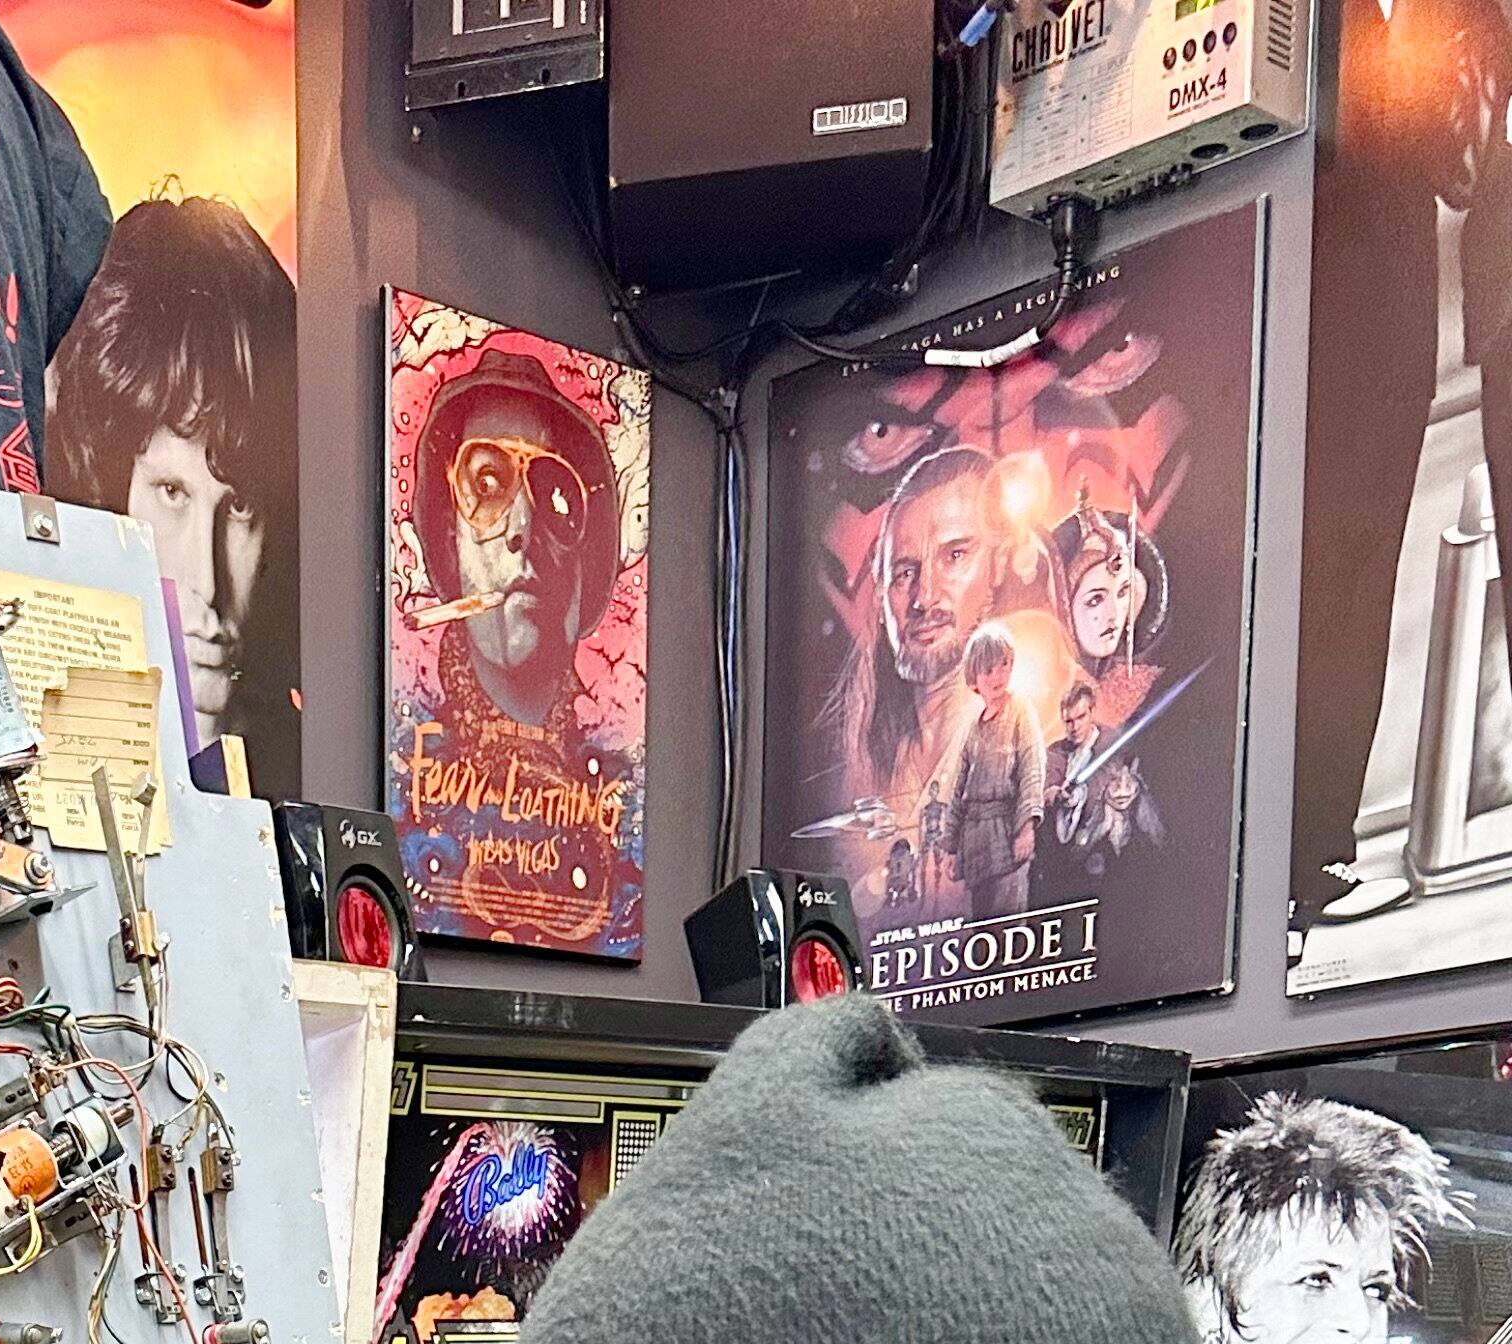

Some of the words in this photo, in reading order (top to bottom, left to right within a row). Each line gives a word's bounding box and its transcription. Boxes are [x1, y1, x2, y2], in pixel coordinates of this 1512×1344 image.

[1169, 67, 1227, 111] DMX-4
[952, 316, 984, 338] HAS
[994, 310, 1005, 321] A
[1015, 266, 1121, 314] BEGINING
[870, 929, 916, 947] STAR
[918, 917, 965, 938] WARS
[870, 918, 1063, 990] EPISODE
[1082, 912, 1098, 952] I
[912, 978, 1005, 1010] PHANTOM
[461, 1142, 549, 1227] Bally
